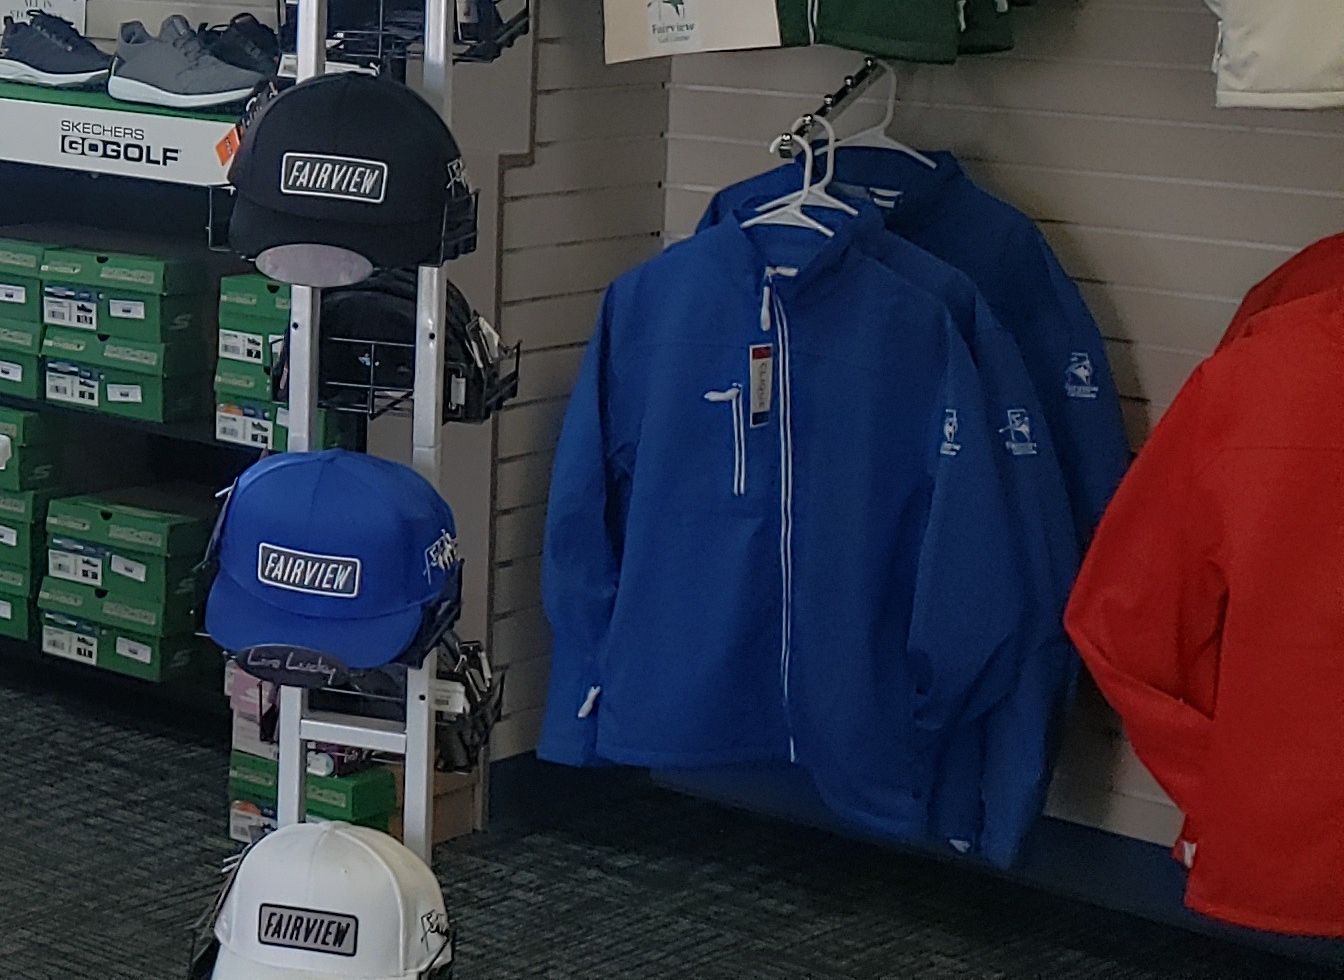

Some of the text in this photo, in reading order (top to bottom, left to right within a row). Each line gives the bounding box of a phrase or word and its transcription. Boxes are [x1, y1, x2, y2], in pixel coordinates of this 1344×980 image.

[60, 120, 145, 140] SKECHERS
[61, 135, 180, 166] GOGOLF
[288, 160, 380, 195] FAIRVIEW
[265, 553, 352, 590] FAIRVIEW
[264, 912, 350, 949] FAIRVIEW
